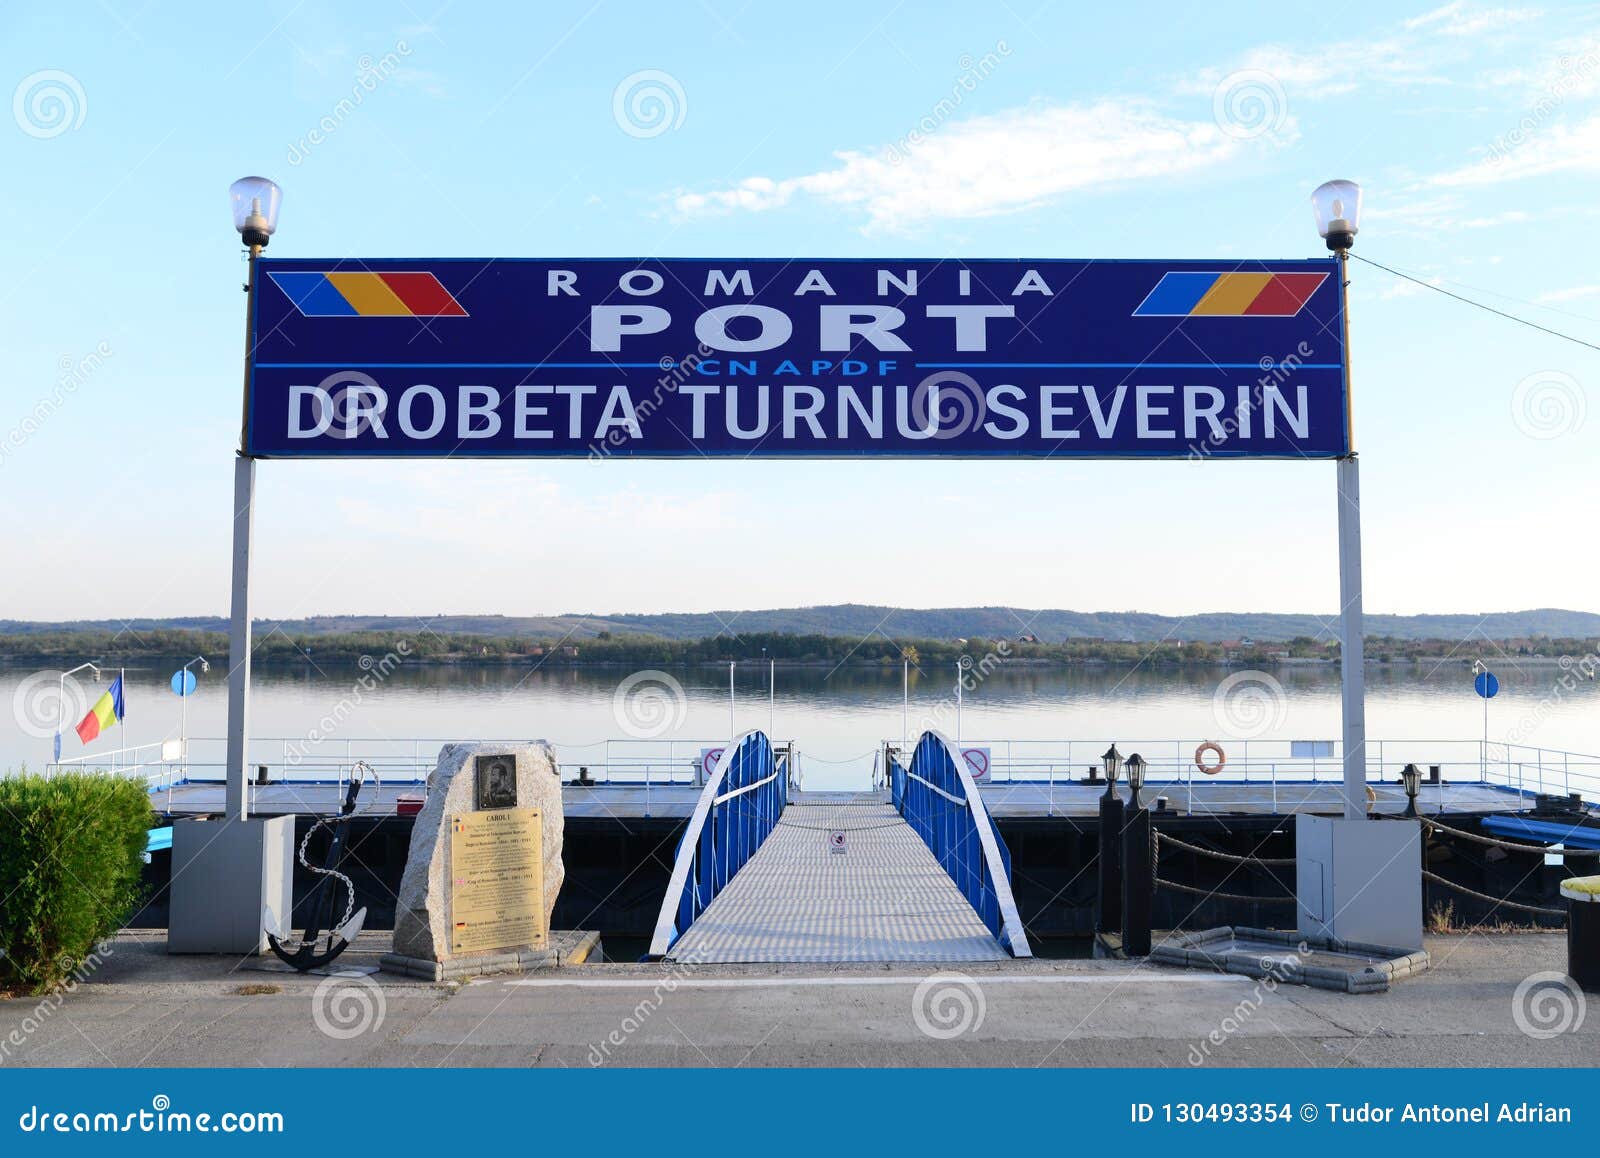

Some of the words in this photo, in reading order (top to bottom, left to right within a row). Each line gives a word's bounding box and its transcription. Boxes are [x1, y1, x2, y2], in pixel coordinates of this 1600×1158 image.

[547, 269, 1054, 296] ROMANIA
[590, 304, 1015, 353] PORT
[287, 384, 644, 440] DROBETA
[679, 384, 941, 440] TURNU
[983, 384, 1309, 440] SEVERIN
